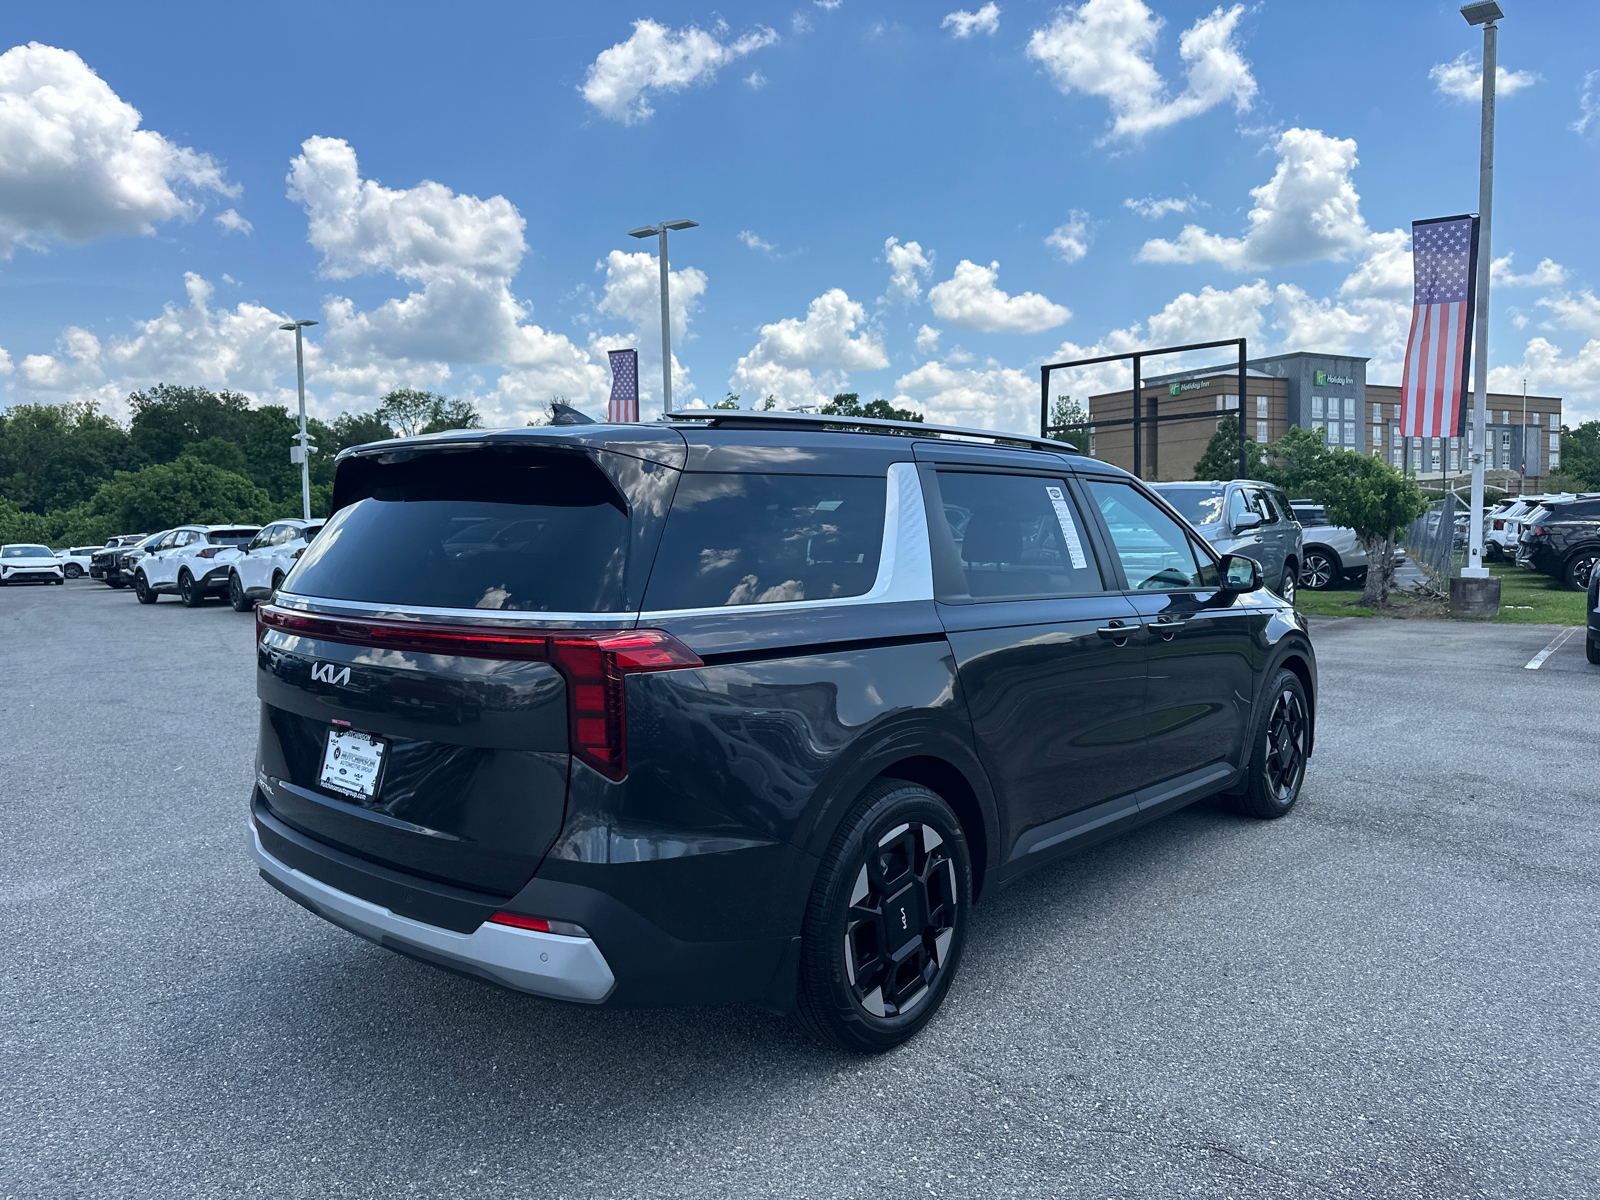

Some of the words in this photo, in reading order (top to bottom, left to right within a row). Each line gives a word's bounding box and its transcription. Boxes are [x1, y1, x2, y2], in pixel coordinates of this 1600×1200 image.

[1327, 374, 1345, 386] Holiday
[1345, 376, 1354, 384] Inn
[1180, 382, 1200, 391] Holiday
